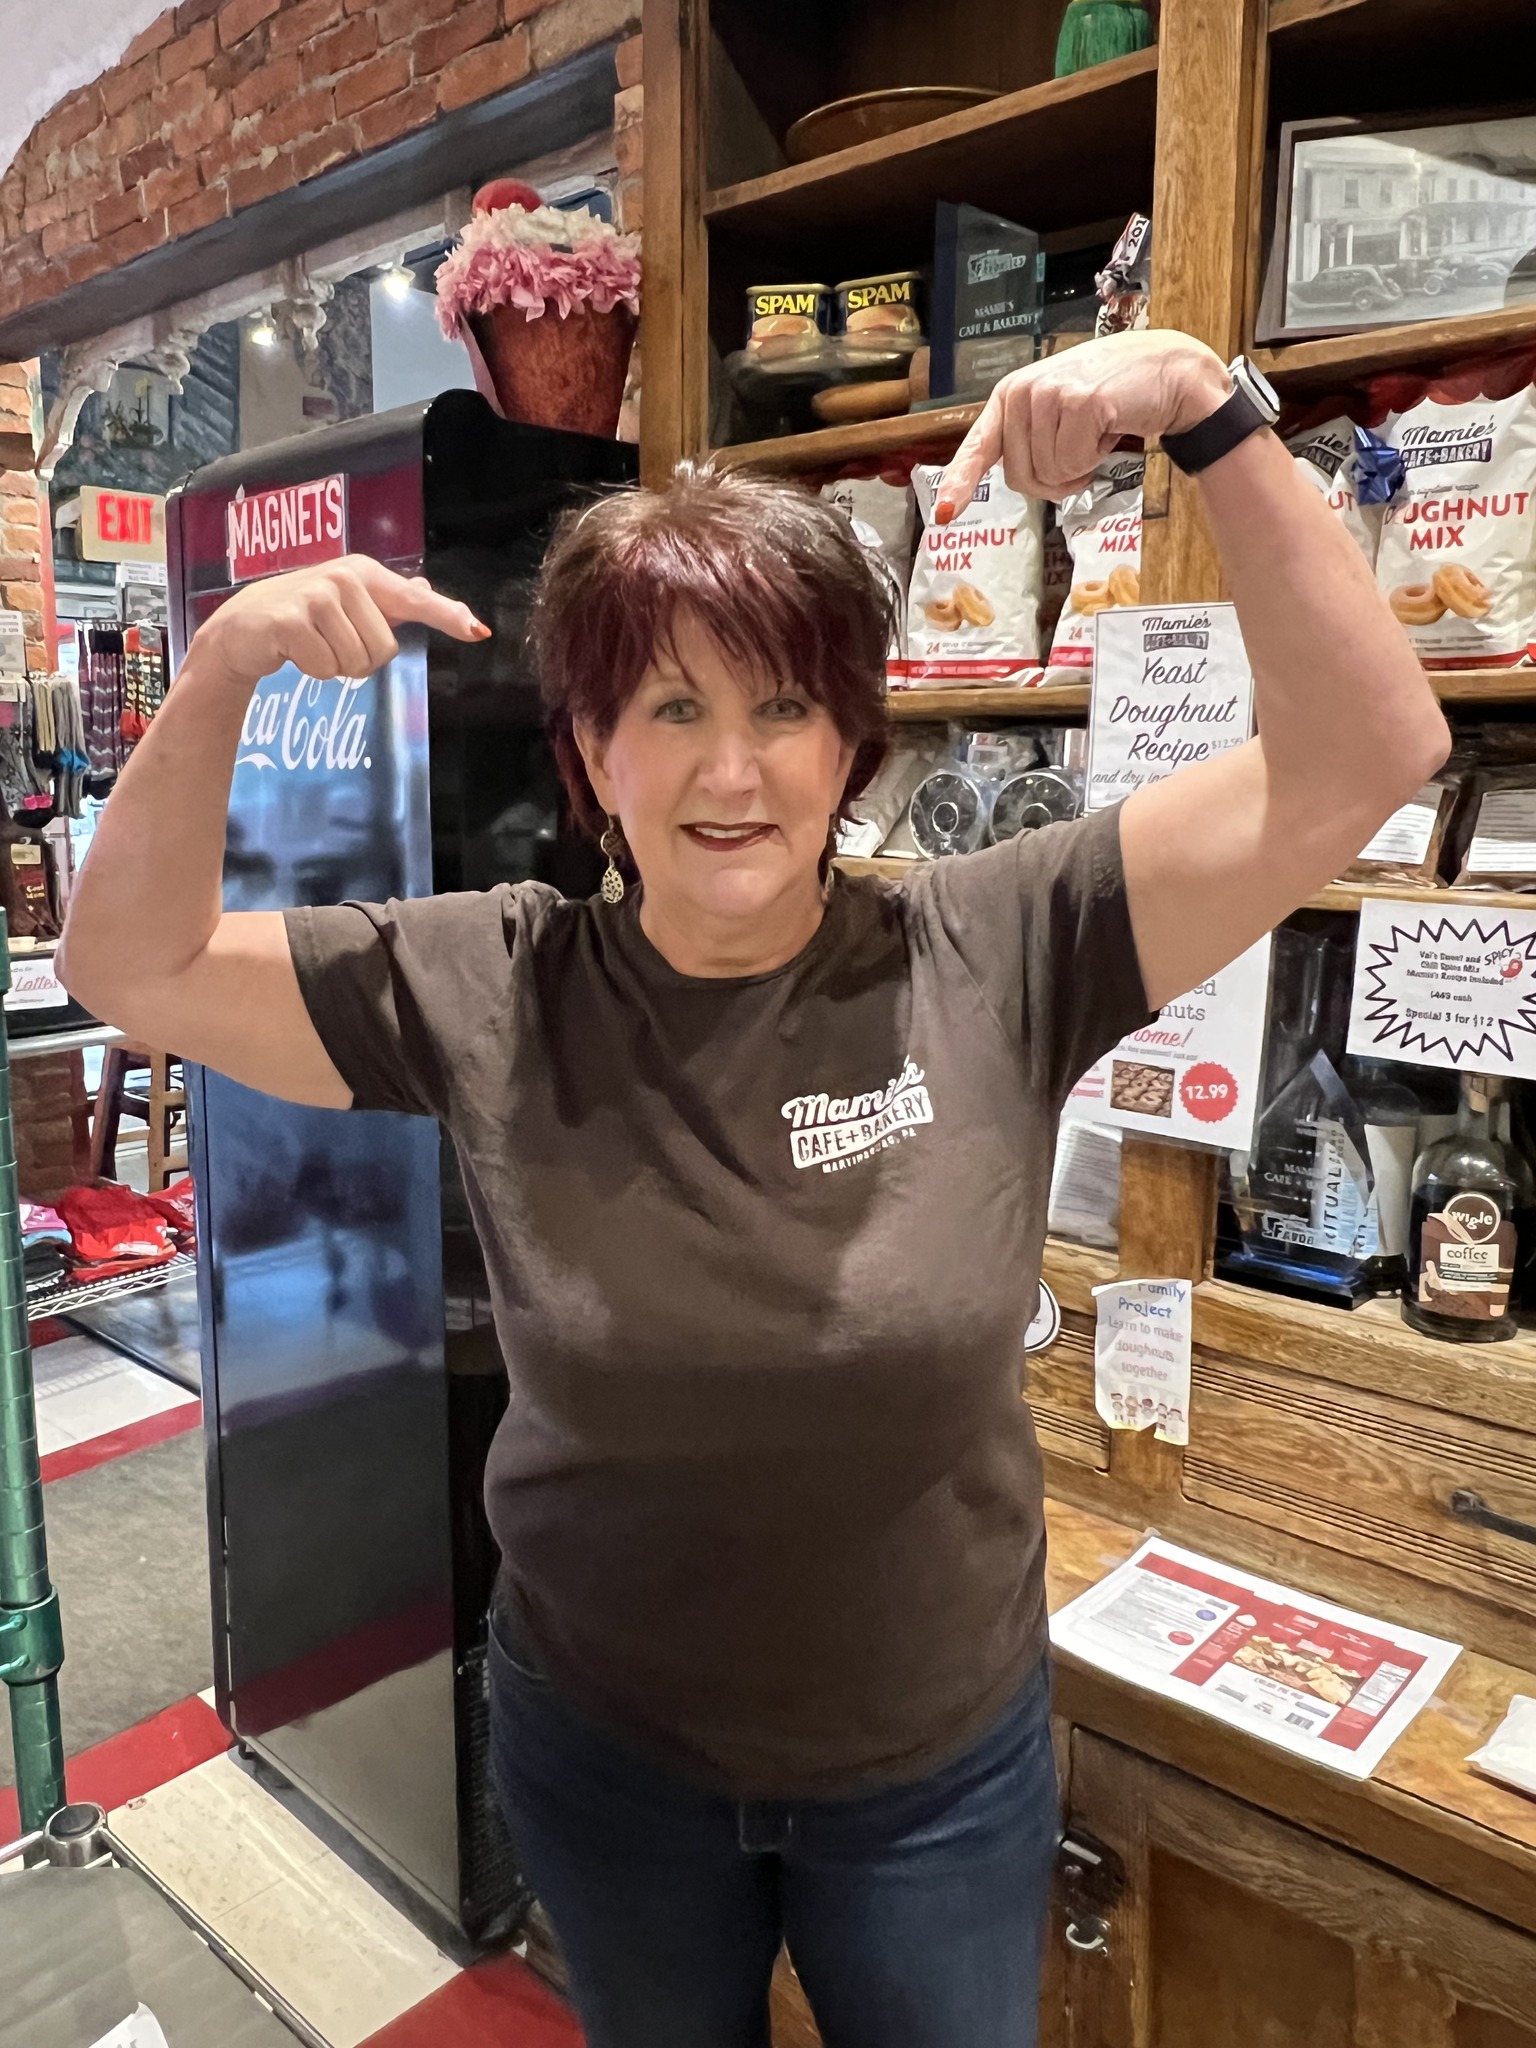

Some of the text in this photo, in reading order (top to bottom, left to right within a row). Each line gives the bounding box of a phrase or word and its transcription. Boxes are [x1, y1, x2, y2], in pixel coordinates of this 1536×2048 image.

[755, 294, 815, 315] SPAM
[848, 281, 911, 308] SPAM
[1402, 414, 1497, 447] Mamie's
[97, 494, 153, 544] EXIT
[229, 479, 342, 559] MAGNETS
[1384, 492, 1529, 525] DUGHNUT
[928, 528, 1017, 551] UGHNUT
[1099, 534, 1141, 553] MIX
[1409, 525, 1465, 551] MIX
[936, 552, 972, 572] MIX
[1142, 610, 1211, 631] Mamie's
[1069, 627, 1082, 640] 24
[927, 643, 940, 655] 24
[1142, 657, 1207, 685] Yeast
[1109, 693, 1238, 738] Doughnut
[1127, 733, 1210, 769] Recipe
[1092, 770, 1117, 784] and
[1120, 770, 1144, 790] dry
[1484, 948, 1514, 966] SPICY
[1445, 1012, 1451, 1022] 3
[1455, 1013, 1470, 1024] for
[1186, 1083, 1229, 1100] 12.99
[1452, 1212, 1493, 1230] wigle
[1447, 1247, 1488, 1259] coffee
[1118, 1297, 1172, 1318] Project
[1108, 1316, 1184, 1342] Learn to make
[1121, 1362, 1168, 1381] together
